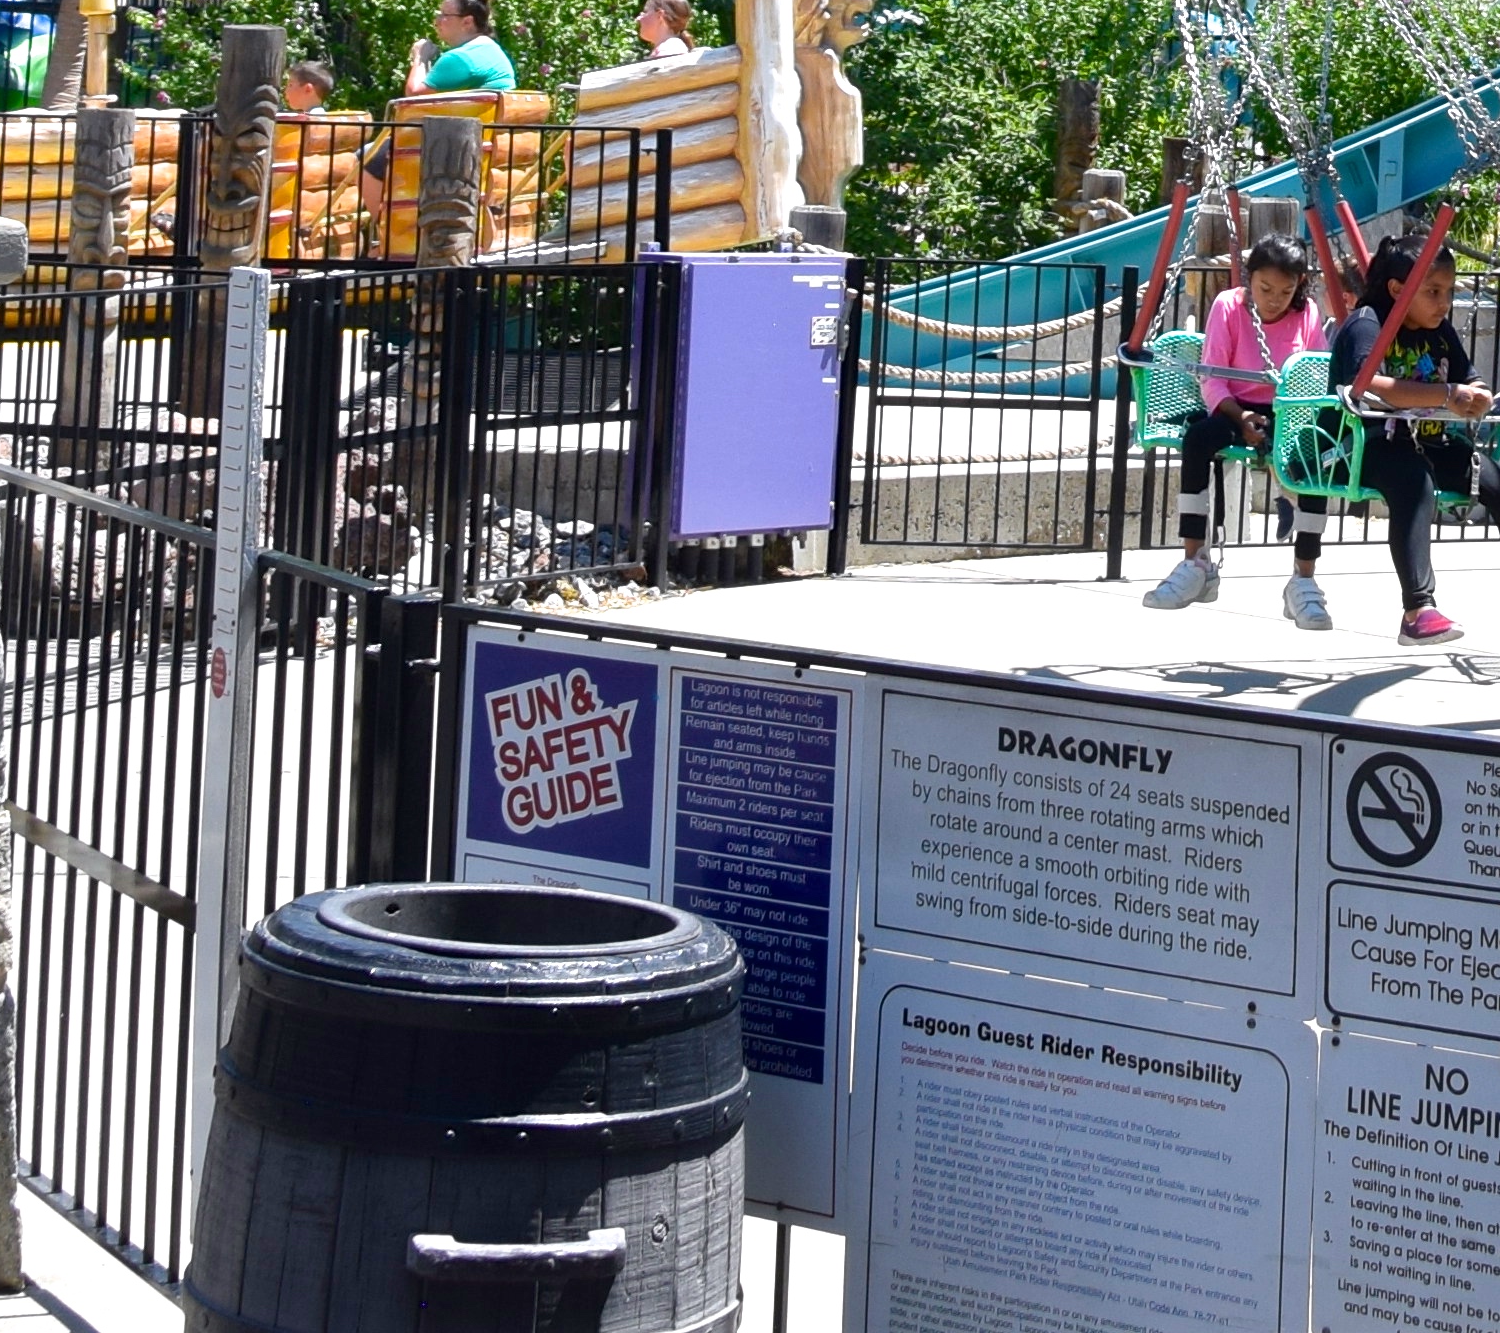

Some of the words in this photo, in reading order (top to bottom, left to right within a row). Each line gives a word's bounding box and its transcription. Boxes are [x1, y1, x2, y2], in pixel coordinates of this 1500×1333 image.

[491, 681, 562, 737] FUN
[570, 675, 596, 715] &
[500, 710, 630, 782] SAFETY
[998, 727, 1173, 774] DRAGONFLY
[507, 763, 618, 826] GUIDE
[893, 748, 922, 771] The
[927, 753, 1008, 789] Dragonfly
[1013, 771, 1083, 795] consists
[1087, 778, 1105, 798] of
[1109, 780, 1131, 802] 24
[1137, 789, 1185, 809] seats
[1190, 796, 1290, 825] suspended
[1466, 781, 1487, 797] No
[912, 777, 932, 804] by
[936, 782, 991, 808] chains
[996, 790, 1035, 814] from
[1040, 798, 1085, 822] three
[1090, 808, 1156, 838] rotating
[1161, 820, 1206, 840] arms
[1211, 824, 1264, 849] which
[1461, 824, 1476, 835] or
[1479, 822, 1491, 837] in
[1464, 803, 1483, 816] on
[930, 812, 978, 834] rotate
[982, 821, 1042, 843] around
[1047, 830, 1058, 846] a
[1064, 833, 1120, 855] center
[1124, 842, 1172, 863] mast.
[1184, 846, 1243, 873] Riders
[921, 840, 1014, 868] experience
[1018, 855, 1029, 870] a
[1035, 857, 1099, 880] smooth
[1104, 865, 1169, 896] orbiting
[1175, 874, 1209, 897] ride
[1214, 880, 1250, 903] with
[911, 861, 945, 884] mild
[950, 871, 1039, 901] centrifugal
[1044, 880, 1102, 908] forces.
[1114, 891, 1171, 918] Riders
[1177, 905, 1215, 925] seat
[1221, 912, 1260, 936] may
[915, 891, 964, 919] swing
[969, 896, 1007, 921] from
[1012, 904, 1113, 938] side-to-side
[1118, 920, 1174, 953] during
[1179, 931, 1208, 953] the
[1213, 936, 1252, 960] ride.
[1337, 907, 1378, 933] Line
[1383, 913, 1473, 952] Jumping
[1351, 939, 1417, 968] Cause
[1423, 949, 1455, 974] For
[1371, 971, 1421, 999] From
[1430, 980, 1464, 1005] The
[902, 1007, 971, 1039] Lagoon
[977, 1020, 1035, 1050] Guest
[1041, 1031, 1095, 1061] Rider
[1101, 1042, 1242, 1093] Responsibility
[1425, 1064, 1469, 1095] NO
[1347, 1087, 1401, 1122] LINE
[1324, 1119, 1351, 1139] The
[1355, 1124, 1429, 1153] Definition
[1434, 1138, 1453, 1157] Of
[1457, 1143, 1490, 1164] Line
[1327, 1150, 1336, 1164] 1.
[1351, 1154, 1396, 1179] Cutting
[1399, 1163, 1411, 1177] in
[1414, 1165, 1443, 1182] front
[1446, 1171, 1459, 1185] of
[1324, 1190, 1334, 1204] 2.
[1350, 1194, 1399, 1220] Leaving
[1402, 1205, 1422, 1220] the
[1425, 1208, 1451, 1227] line,
[1455, 1214, 1484, 1231] then
[1352, 1177, 1397, 1199] waiting
[1400, 1183, 1411, 1198] in
[1414, 1187, 1435, 1203] the
[1438, 1191, 1464, 1208] line.
[1323, 1230, 1333, 1244] 3.
[1349, 1234, 1391, 1259] Saving
[1393, 1246, 1403, 1257] a
[1406, 1246, 1443, 1265] place
[1446, 1253, 1463, 1269] for
[1351, 1216, 1364, 1231] to
[1366, 1221, 1417, 1241] re-enter
[1420, 1231, 1434, 1244] at
[1437, 1233, 1458, 1248] the
[1461, 1239, 1496, 1256] same
